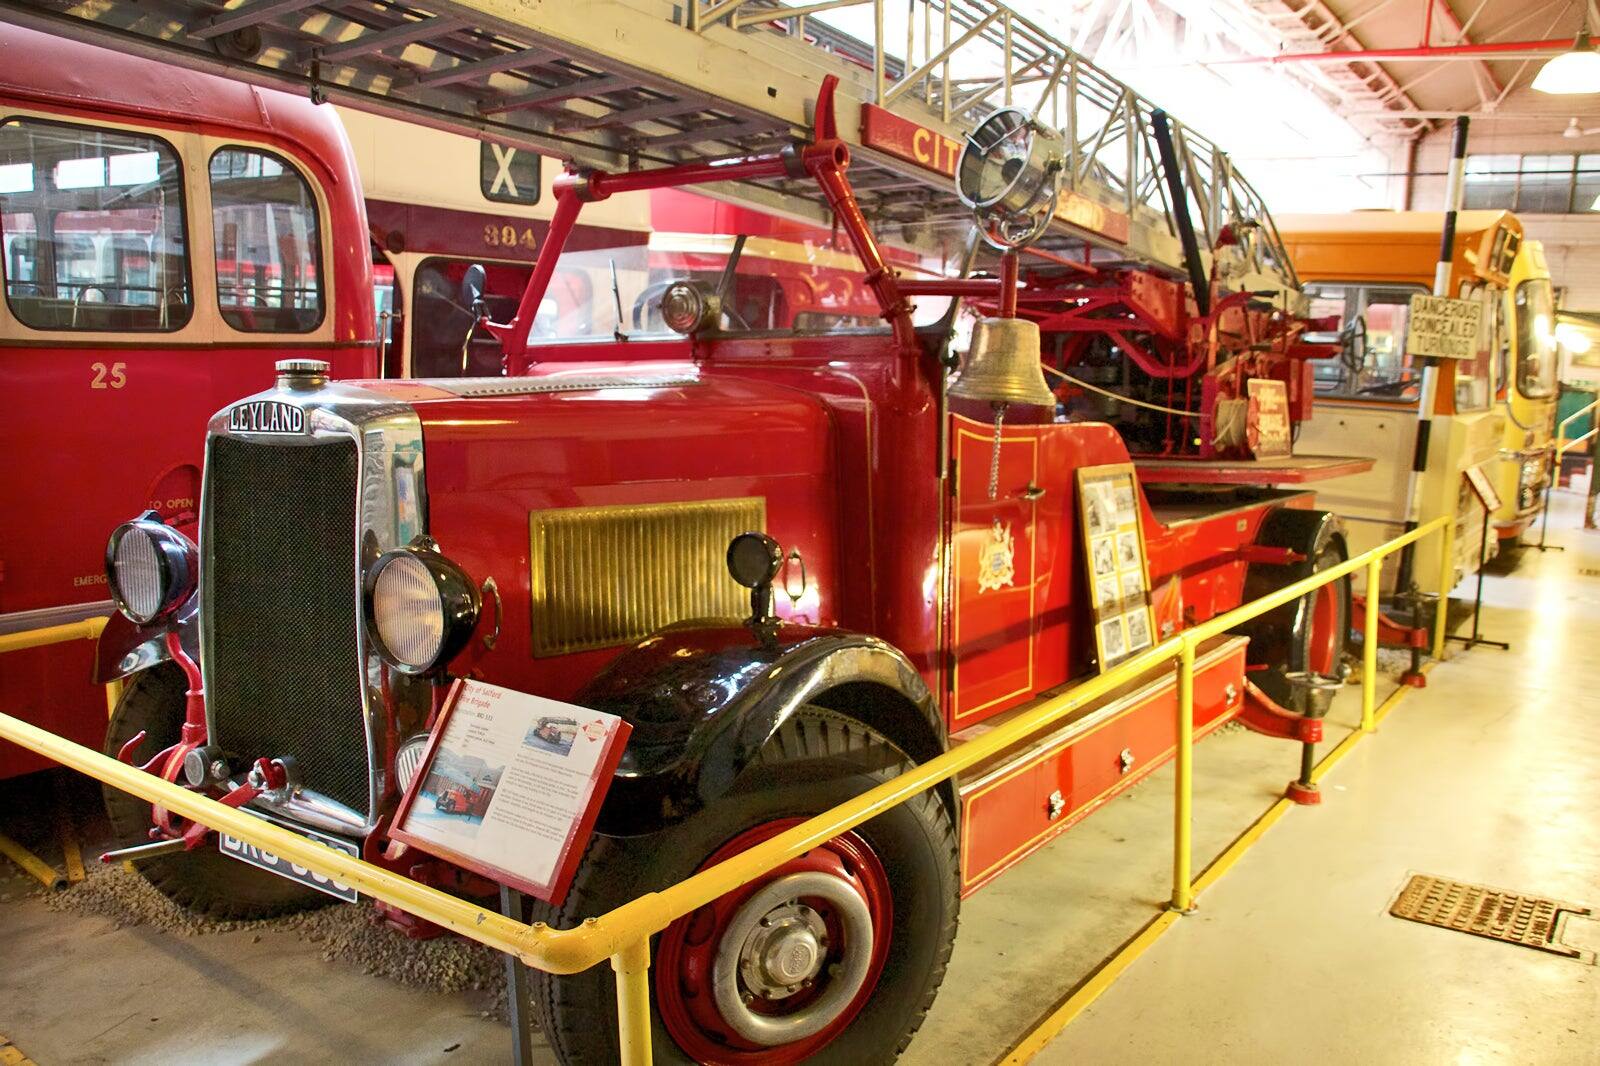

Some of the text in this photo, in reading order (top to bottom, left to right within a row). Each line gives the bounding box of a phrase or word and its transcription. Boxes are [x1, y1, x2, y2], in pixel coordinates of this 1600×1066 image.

[913, 128, 961, 174] CIT
[490, 142, 519, 197] X
[1411, 316, 1476, 338] CONCEALED
[91, 362, 126, 389] 25
[231, 402, 302, 431] LEYLAND
[149, 498, 193, 509] TO OPEN
